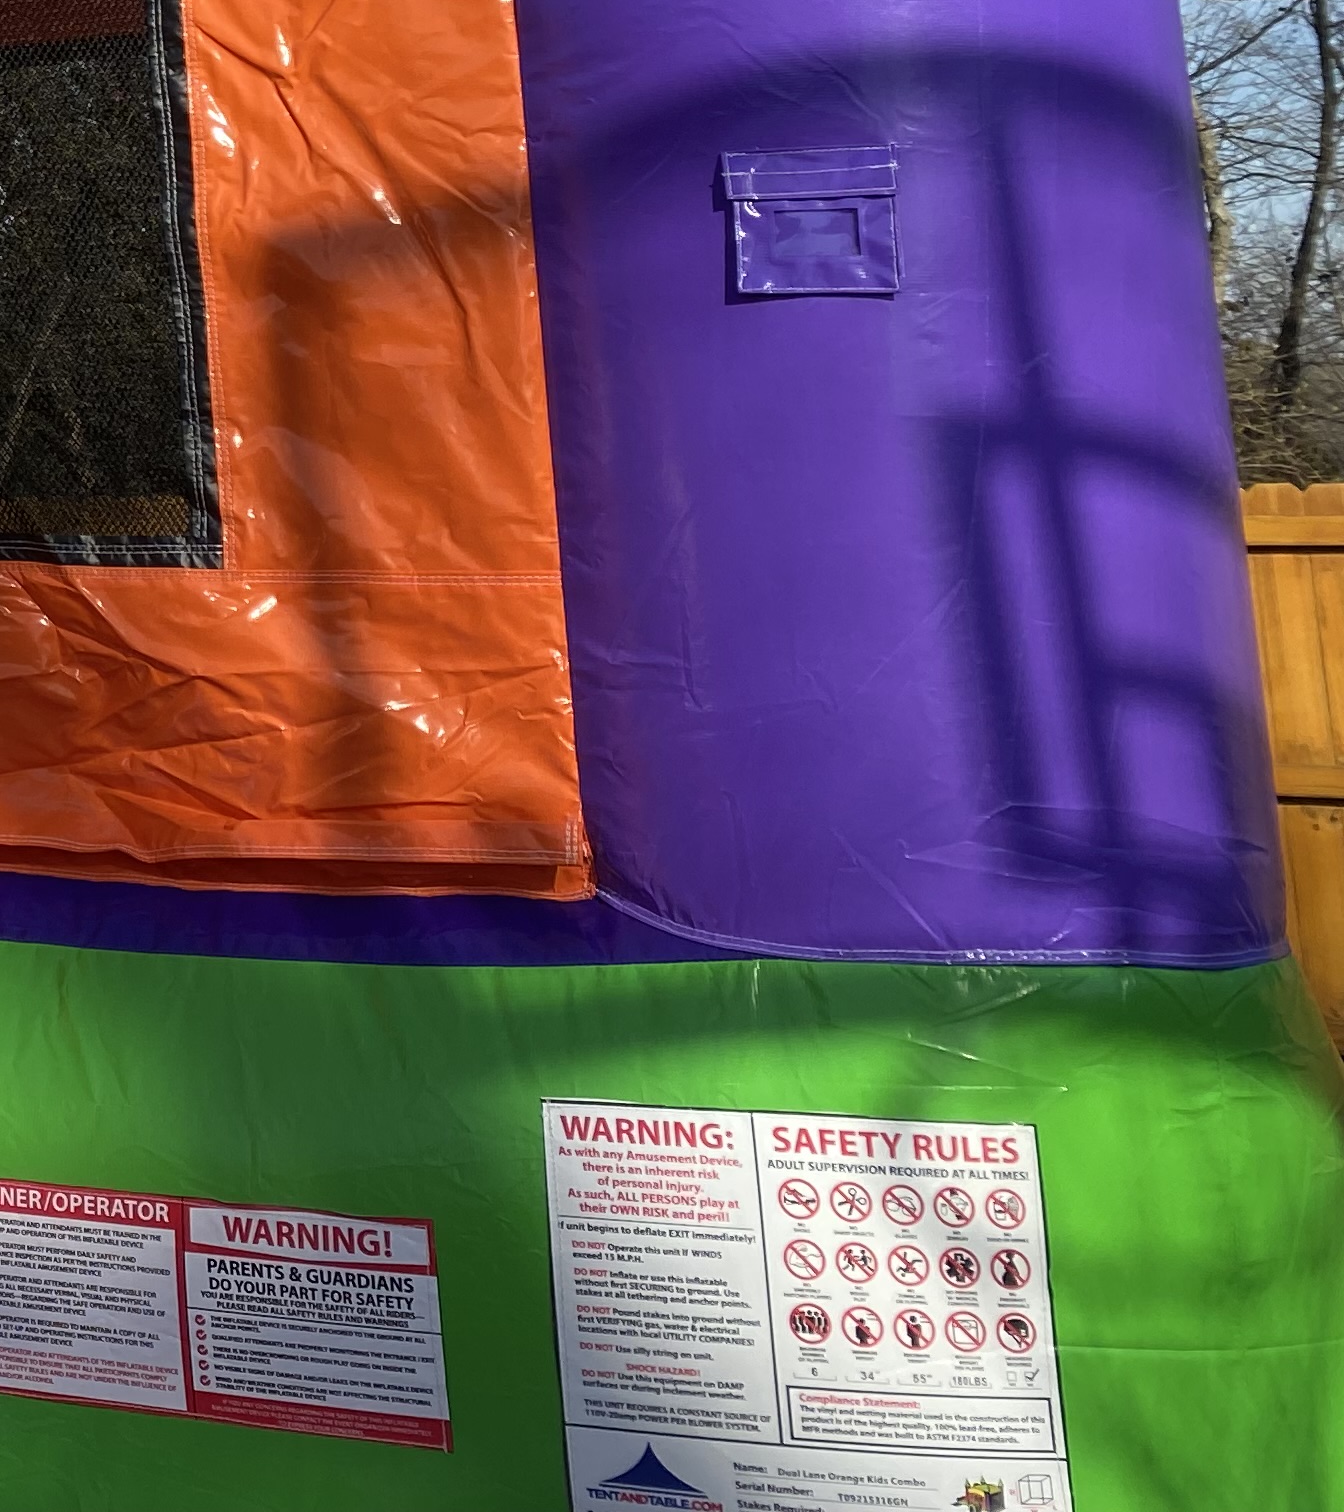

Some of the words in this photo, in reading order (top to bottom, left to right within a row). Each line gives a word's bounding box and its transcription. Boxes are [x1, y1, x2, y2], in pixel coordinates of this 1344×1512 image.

[560, 1115, 735, 1150] WARNING:
[771, 1126, 902, 1159] SAFETY
[912, 1133, 1020, 1165] RULES
[558, 1146, 572, 1156] As
[575, 1148, 600, 1158] with
[602, 1151, 623, 1162] any
[626, 1151, 696, 1164] Amusement
[699, 1155, 743, 1168] Device,
[582, 1163, 613, 1173] there
[616, 1164, 625, 1174] is
[627, 1167, 642, 1175] an
[644, 1166, 695, 1178] inherent
[698, 1169, 720, 1180] risk
[767, 1159, 805, 1170] ADULT
[808, 1162, 887, 1175] SUPERVISION
[889, 1166, 949, 1178] REQUIRED
[952, 1169, 965, 1179] AT
[968, 1170, 990, 1180] ALL
[992, 1170, 1030, 1181] TIMES!
[597, 1176, 609, 1186] of
[612, 1179, 663, 1189] personal
[665, 1181, 704, 1194] injury.
[567, 1188, 582, 1198] As
[584, 1190, 614, 1202] such,
[617, 1191, 639, 1202] ALL
[641, 1193, 697, 1206] PERSONS
[699, 1197, 725, 1210] play
[728, 1200, 739, 1209] at
[579, 1203, 607, 1213] their
[610, 1205, 640, 1216] OWN
[642, 1207, 670, 1218] RISK
[672, 1210, 694, 1219] and
[222, 1215, 393, 1258] WARNING!
[566, 1221, 586, 1231] unit
[587, 1222, 619, 1234] begins
[621, 1225, 631, 1234] to
[633, 1225, 666, 1236] deflate
[669, 1228, 689, 1238] EXIT
[572, 1240, 586, 1249] DO
[587, 1241, 607, 1250] NOT
[608, 1242, 642, 1253] Operate
[644, 1245, 661, 1254] this
[663, 1247, 681, 1256] unit
[682, 1248, 689, 1257] if
[691, 1249, 723, 1259] WINDS
[207, 1258, 285, 1280] PARENTS
[289, 1267, 302, 1282] &
[306, 1268, 415, 1293] GUARDIANS
[574, 1267, 587, 1276] DO
[589, 1268, 608, 1277] NOT
[609, 1270, 637, 1279] Inflate
[651, 1274, 666, 1282] use
[668, 1274, 683, 1283] this
[686, 1275, 728, 1286] inflatable
[209, 1277, 232, 1291] DO
[234, 1279, 275, 1296] YOUR
[280, 1284, 318, 1300] PART
[322, 1289, 352, 1304] FOR
[356, 1292, 414, 1310] SAFETY
[575, 1278, 608, 1288] without
[610, 1280, 628, 1289] first
[629, 1282, 675, 1293] SECURING
[676, 1286, 686, 1294] to
[724, 1289, 740, 1298] Use
[575, 1289, 603, 1297] stakes
[615, 1291, 626, 1299] all
[627, 1292, 668, 1304] tethering
[670, 1296, 687, 1304] and
[689, 1297, 719, 1306] anchor
[200, 1290, 217, 1299] YOU
[219, 1291, 234, 1300] ARE
[236, 1293, 289, 1307] RESPONSIBLE
[290, 1299, 307, 1308] FOR
[308, 1301, 323, 1310] THE
[325, 1303, 356, 1314] SAFETY
[357, 1307, 368, 1315] OF
[369, 1308, 385, 1317] ALL
[216, 1300, 245, 1311] PLEASE
[247, 1303, 269, 1313] READ
[270, 1305, 285, 1314] ALL
[286, 1307, 316, 1318] SAFETY
[318, 1311, 343, 1321] RULES
[345, 1314, 363, 1323] AND
[364, 1316, 409, 1328] WARNINGS
[576, 1305, 591, 1313] DO
[592, 1306, 611, 1315] NOT
[613, 1307, 641, 1317] Pound
[643, 1311, 670, 1320] stakes
[672, 1312, 689, 1321] into
[691, 1316, 724, 1324] ground
[726, 1317, 761, 1327] without
[777, 1466, 801, 1477] Dual
[802, 1469, 826, 1480] Lane
[827, 1471, 865, 1484] Orange
[867, 1474, 889, 1484] Kids
[890, 1476, 926, 1487] Combo
[735, 1481, 765, 1493] Serial
[767, 1484, 814, 1496] Number:
